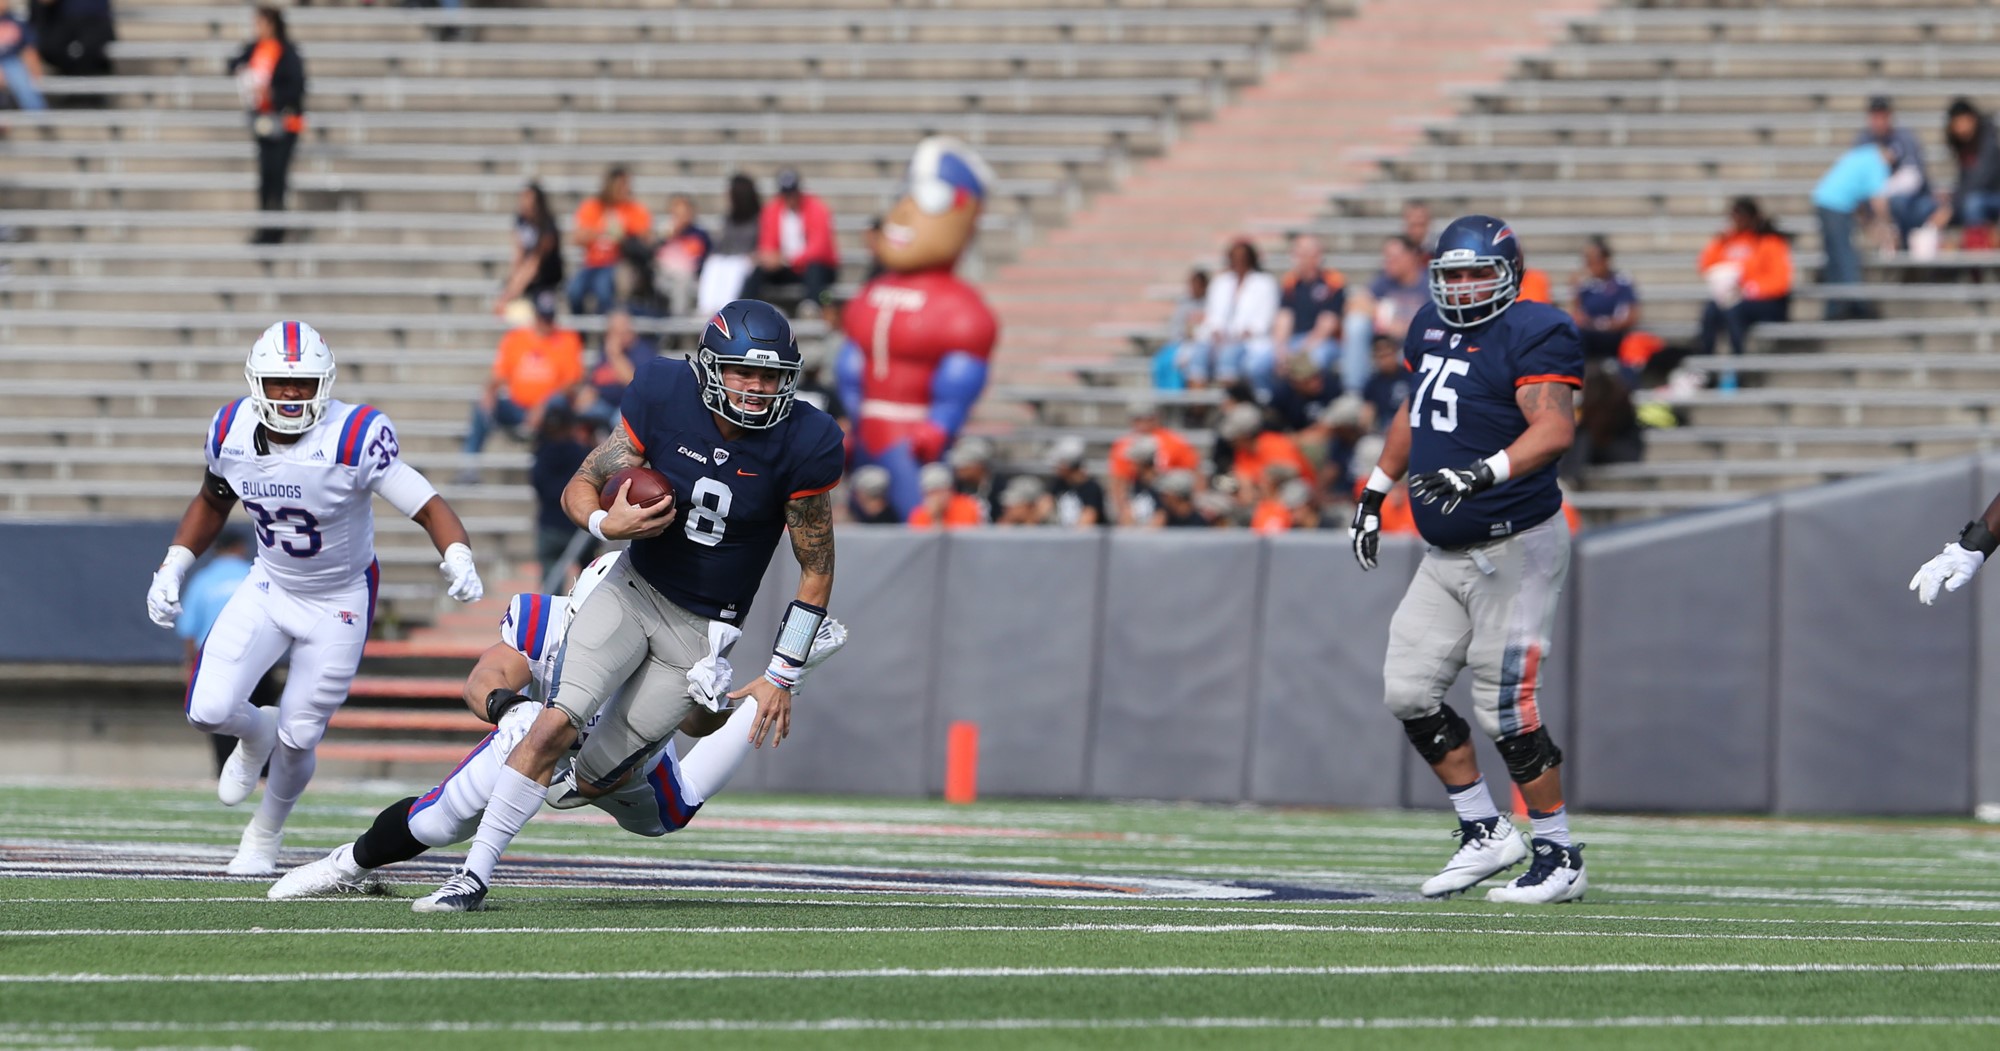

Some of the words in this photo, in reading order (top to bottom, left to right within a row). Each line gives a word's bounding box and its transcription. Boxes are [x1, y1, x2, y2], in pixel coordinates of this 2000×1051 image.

[1410, 353, 1470, 433] 75
[368, 426, 399, 470] 33
[242, 481, 302, 499] BULLDOGS
[684, 476, 733, 547] 8
[242, 500, 322, 558] 33
